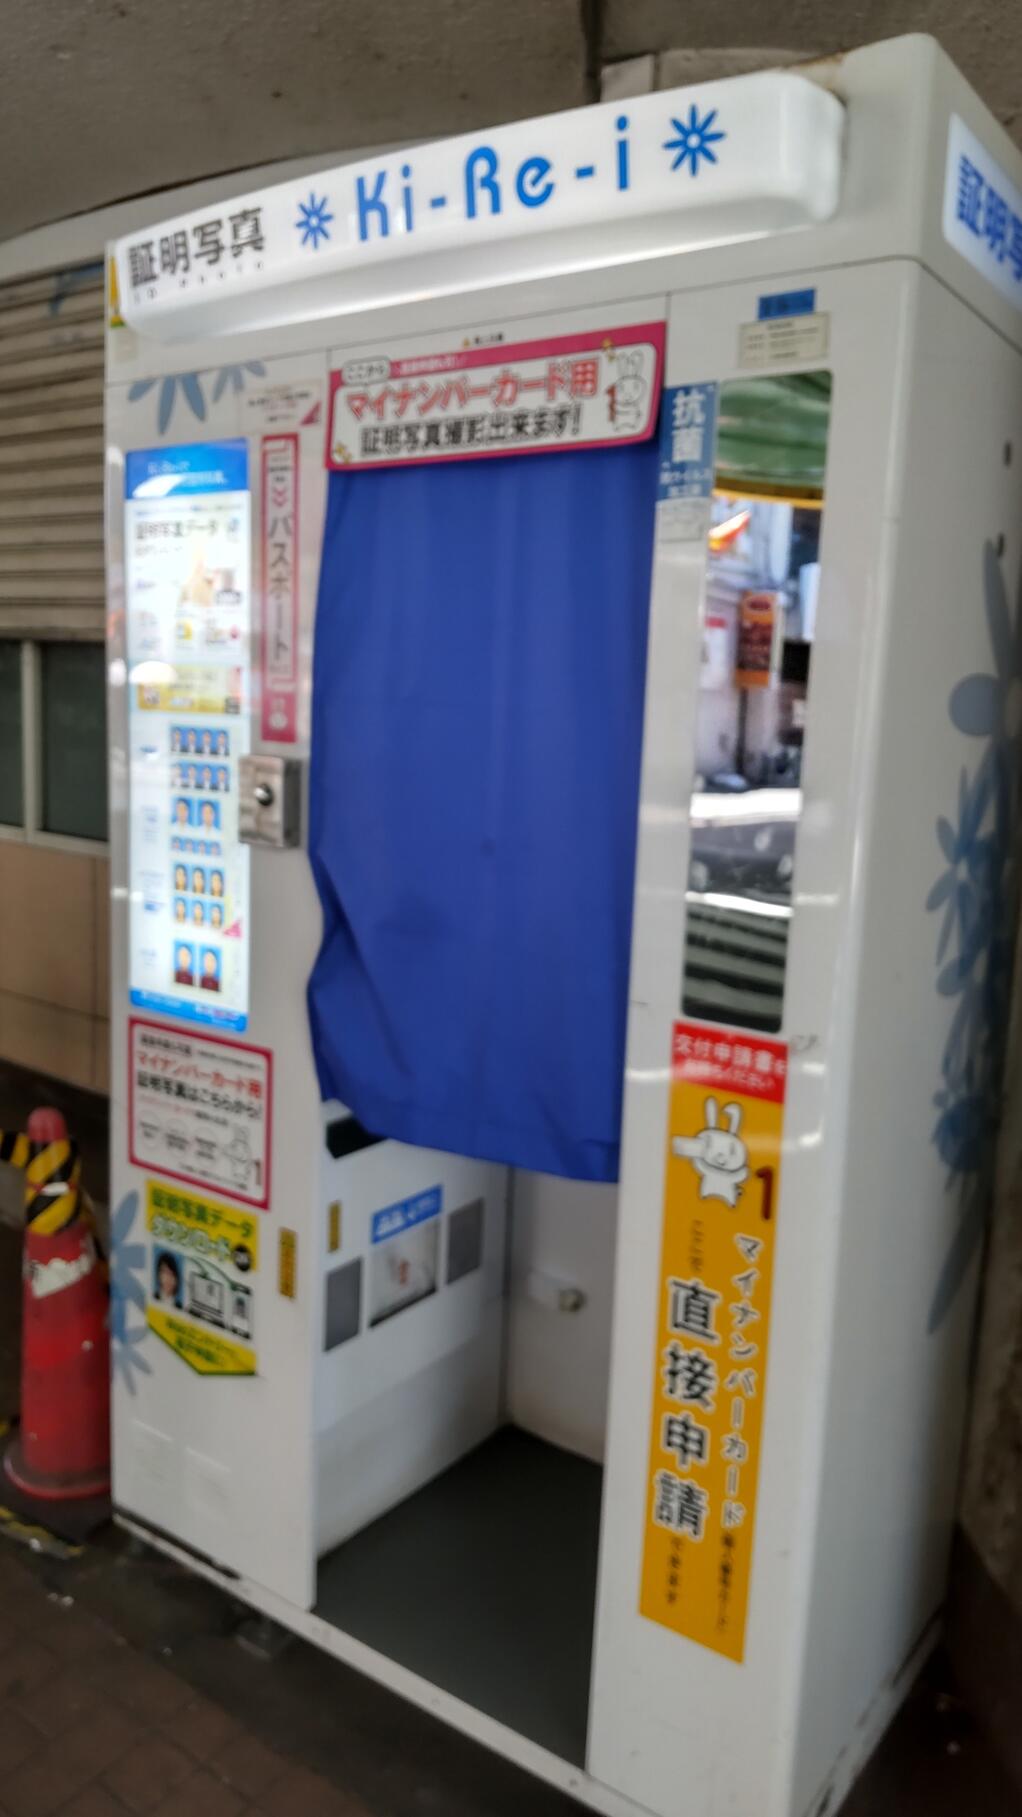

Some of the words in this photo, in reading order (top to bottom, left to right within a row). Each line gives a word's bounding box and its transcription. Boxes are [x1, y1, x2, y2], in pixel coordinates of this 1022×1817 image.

[355, 116, 631, 242] Ki-Re-i
[128, 206, 266, 288] 証明写真
[346, 357, 599, 422] マイナンバーカード用
[651, 1277, 722, 1545] 直接申請
[720, 1231, 765, 1531] マイナンバーカード
